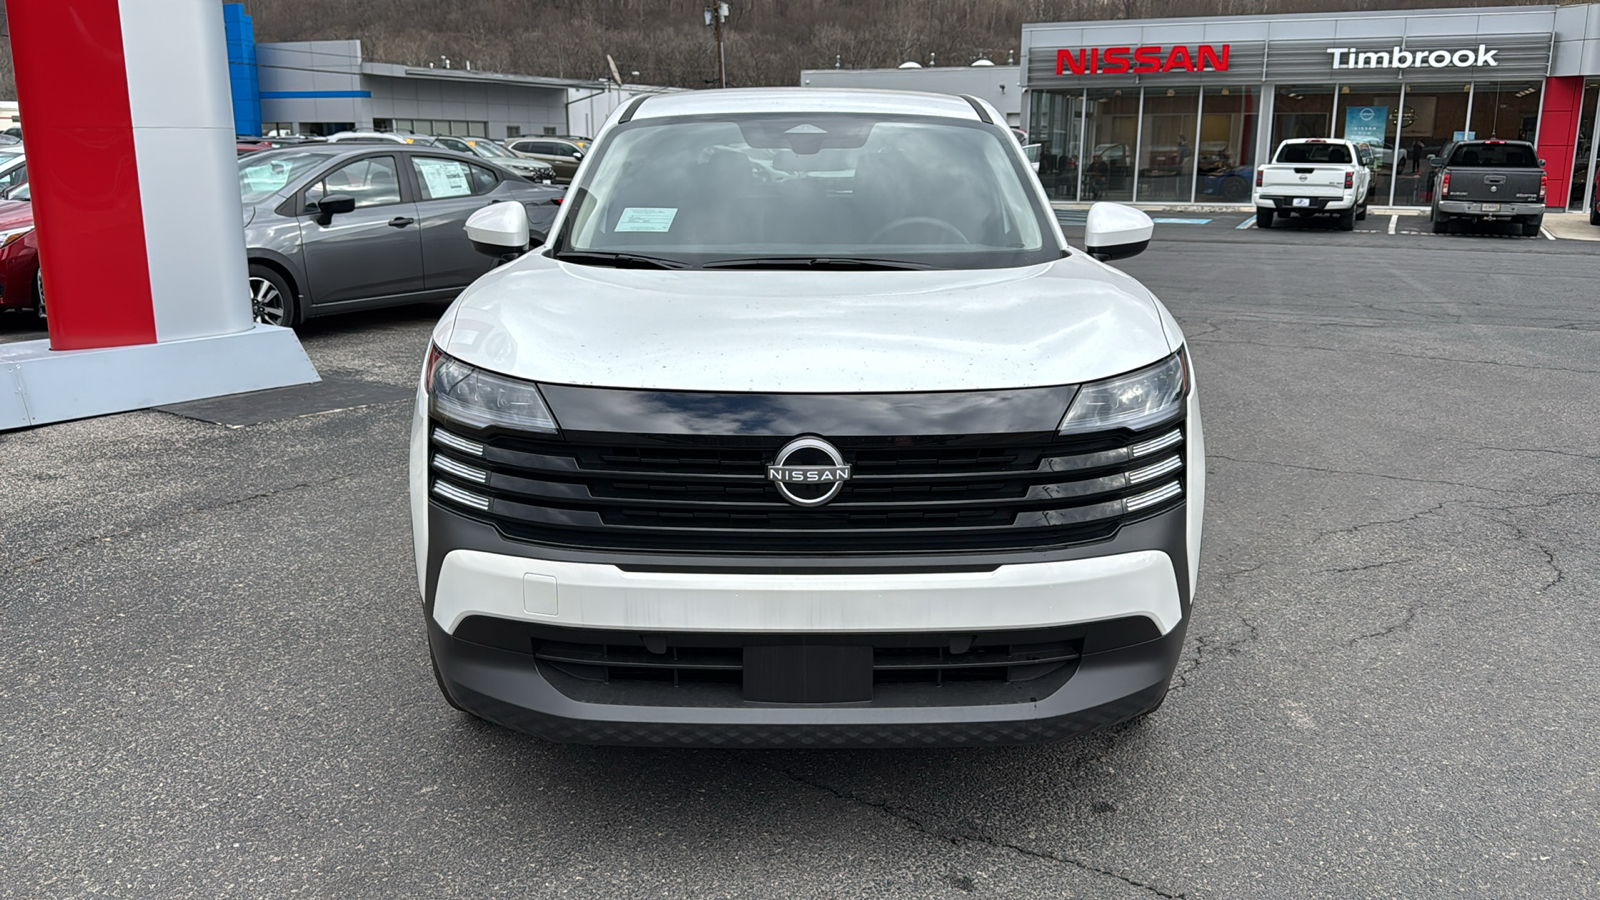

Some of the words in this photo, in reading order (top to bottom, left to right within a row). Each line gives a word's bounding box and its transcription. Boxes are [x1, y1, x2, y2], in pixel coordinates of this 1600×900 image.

[1055, 44, 1230, 75] NISSAN
[1326, 44, 1499, 69] Timbrook
[769, 468, 848, 481] NISSAN
